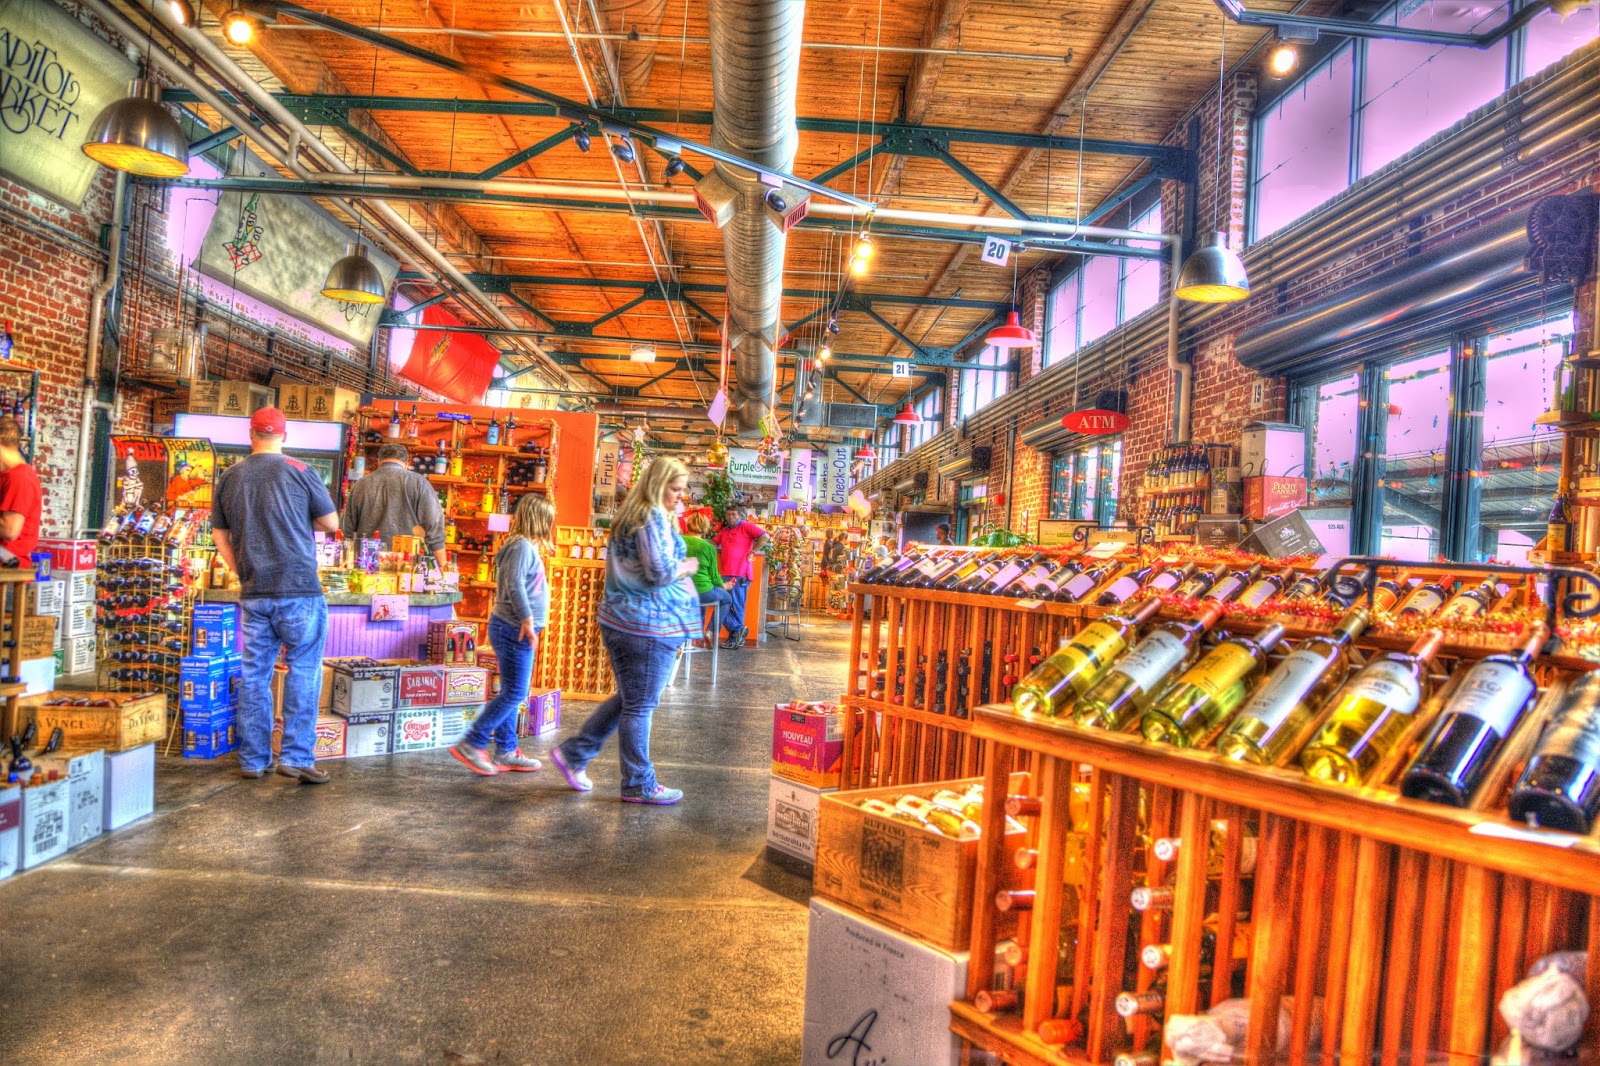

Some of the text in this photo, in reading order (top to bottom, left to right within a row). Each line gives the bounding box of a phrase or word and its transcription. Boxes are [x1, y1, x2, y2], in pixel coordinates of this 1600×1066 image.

[0, 69, 79, 140] RKET
[987, 241, 1005, 260] 20
[896, 364, 905, 375] 21
[1254, 384, 1261, 403] 19
[1078, 415, 1116, 429] ATM
[600, 453, 614, 486] Fruit
[730, 460, 755, 472] Purple
[793, 461, 806, 490] Dairy
[831, 447, 847, 504] Check-Out
[1271, 487, 1298, 495] CANYON
[1273, 481, 1296, 490] PEACHY
[406, 676, 437, 690] SARANAC
[782, 730, 813, 745] NOUVEAU
[864, 817, 905, 837] RUFFINO
